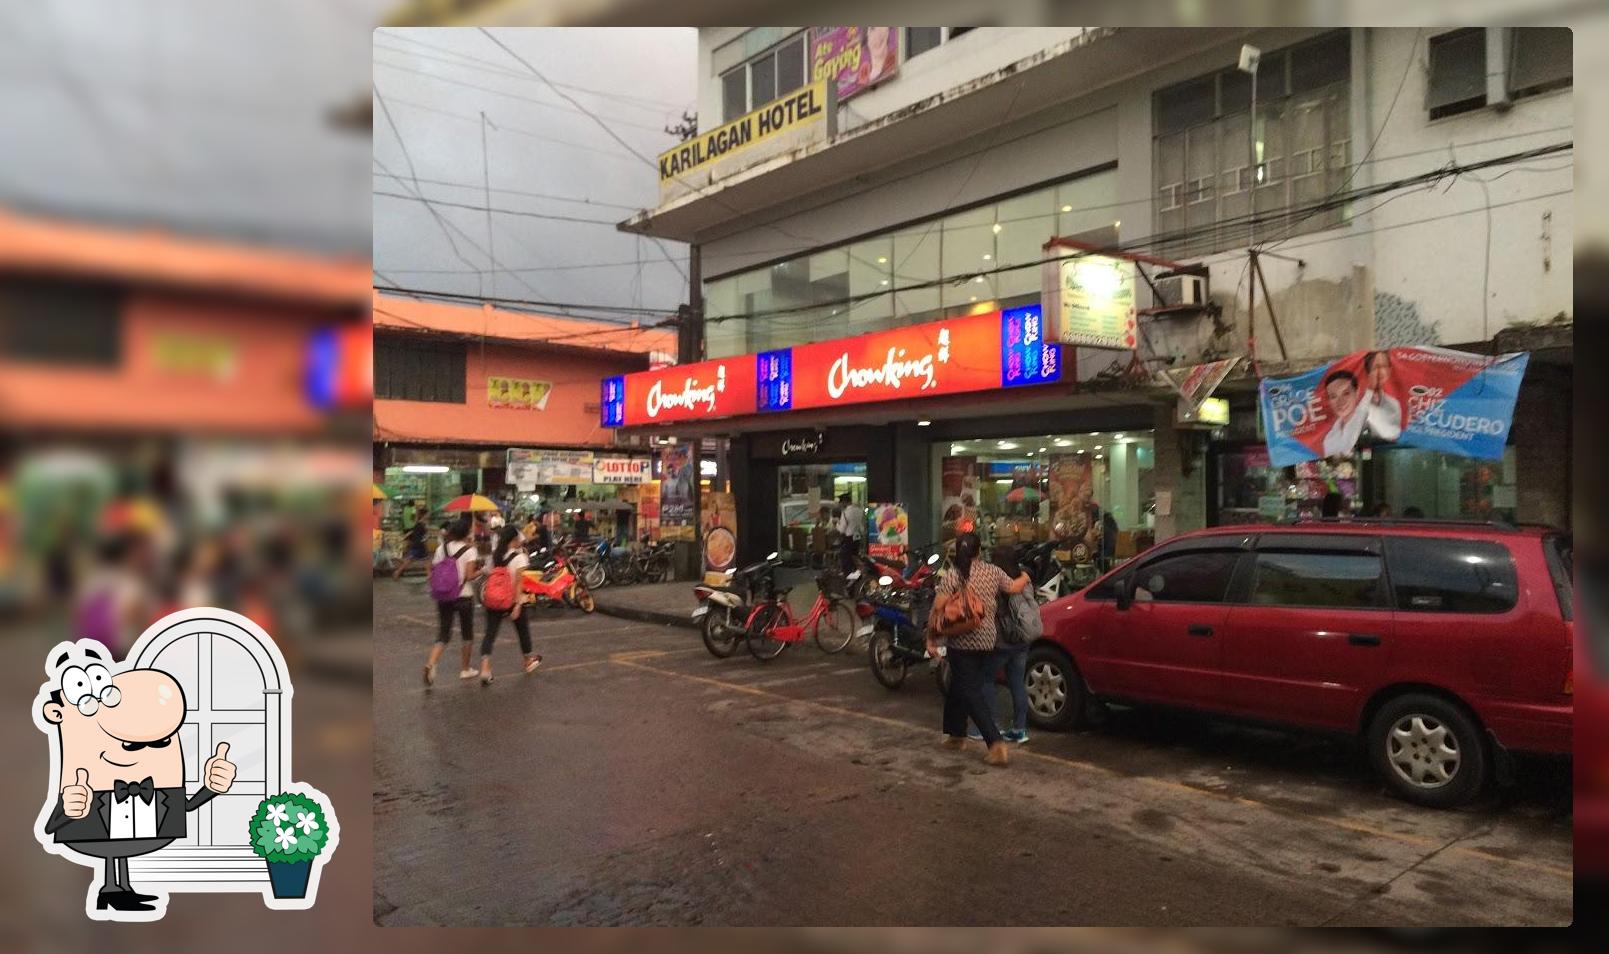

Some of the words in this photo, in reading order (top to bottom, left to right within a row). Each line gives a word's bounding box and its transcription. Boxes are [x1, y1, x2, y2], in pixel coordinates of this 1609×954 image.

[660, 118, 752, 179] KARILAGAN
[758, 89, 822, 136] HOTEL
[828, 347, 934, 399] Chowking
[646, 377, 716, 418] Chowking
[1272, 397, 1328, 432] POE
[1408, 396, 1447, 412] CHIZ
[1408, 407, 1505, 435] ESCUDERO
